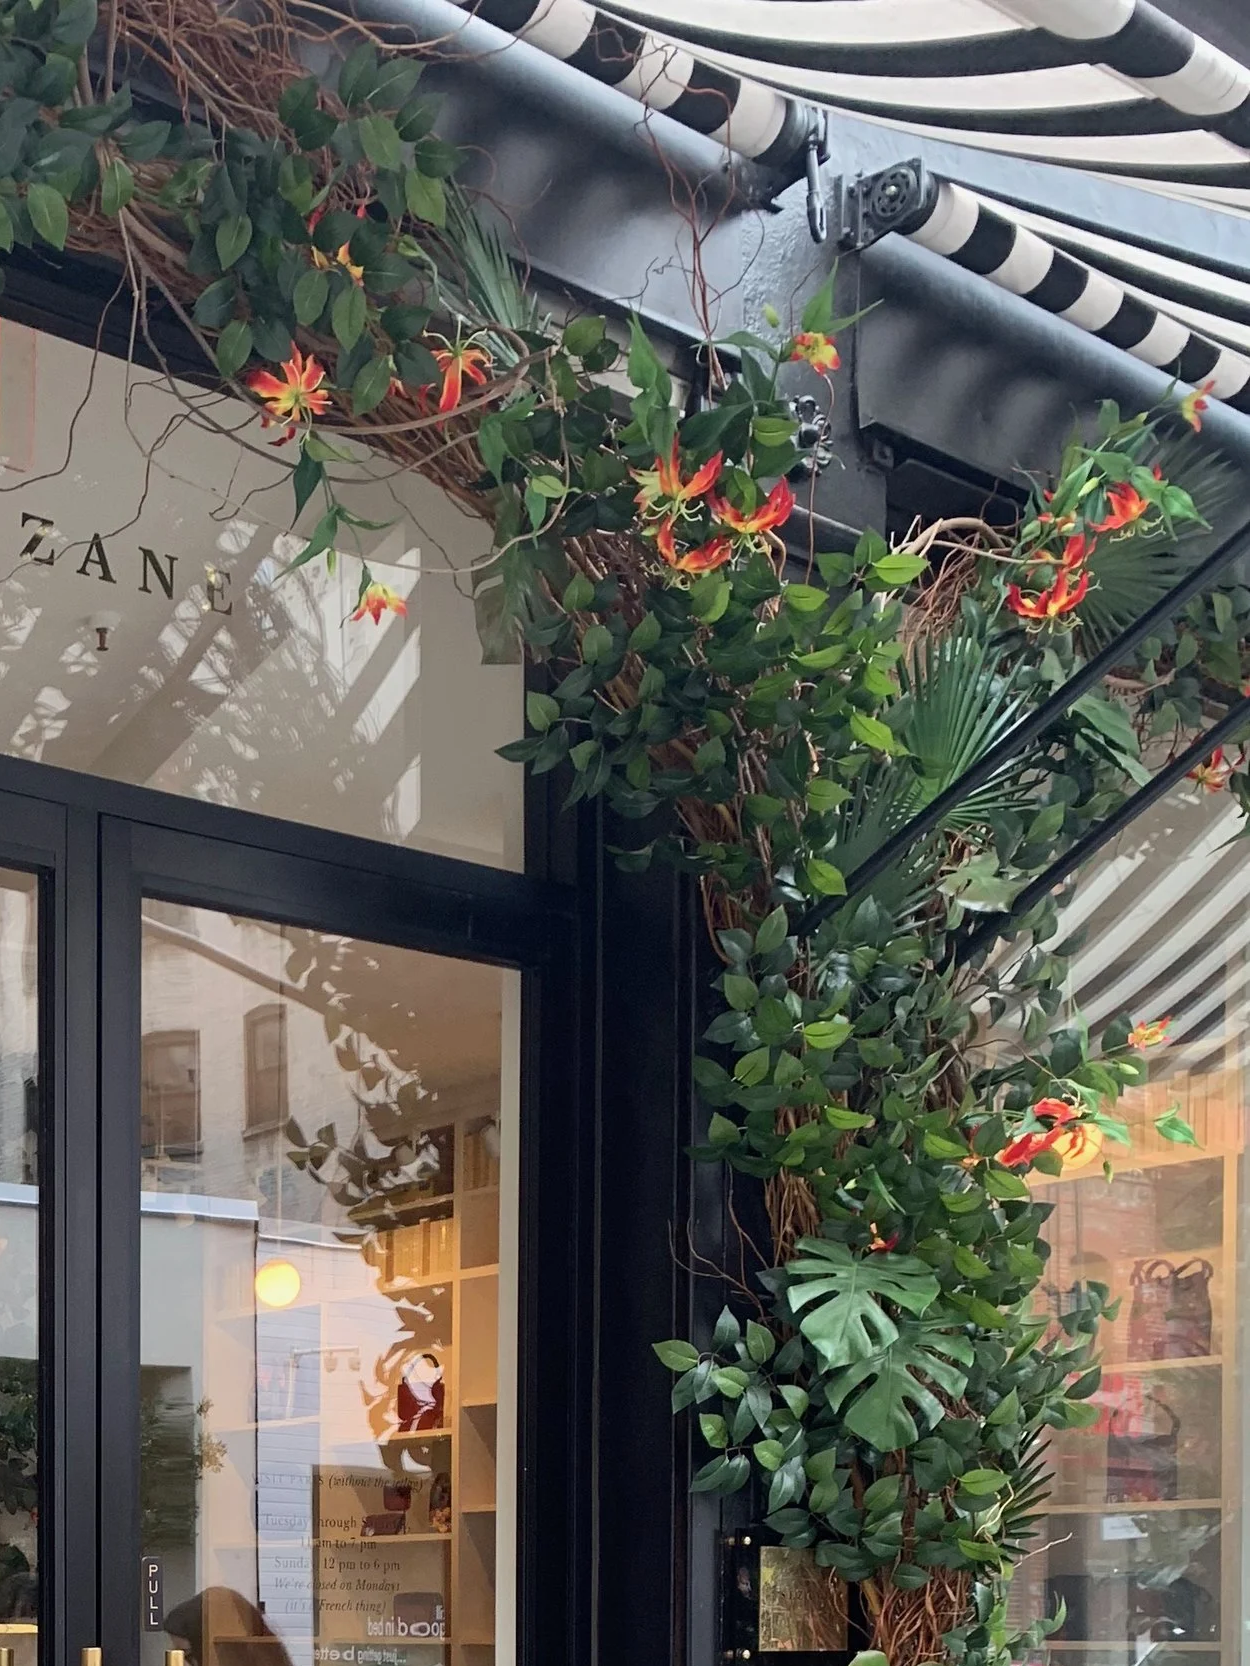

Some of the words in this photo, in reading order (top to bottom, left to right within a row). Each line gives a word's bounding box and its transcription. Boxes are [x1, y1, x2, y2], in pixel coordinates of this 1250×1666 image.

[290, 1474, 323, 1486] PARS
[335, 1538, 348, 1549] to
[360, 1541, 377, 1552] pm
[323, 1558, 335, 1570] 12
[338, 1560, 356, 1573] pm
[360, 1559, 370, 1570] to
[373, 1559, 380, 1570] 6
[383, 1561, 400, 1574] pm
[340, 1581, 352, 1591] on
[148, 1564, 159, 1625] PULL
[356, 1599, 387, 1614] thing)
